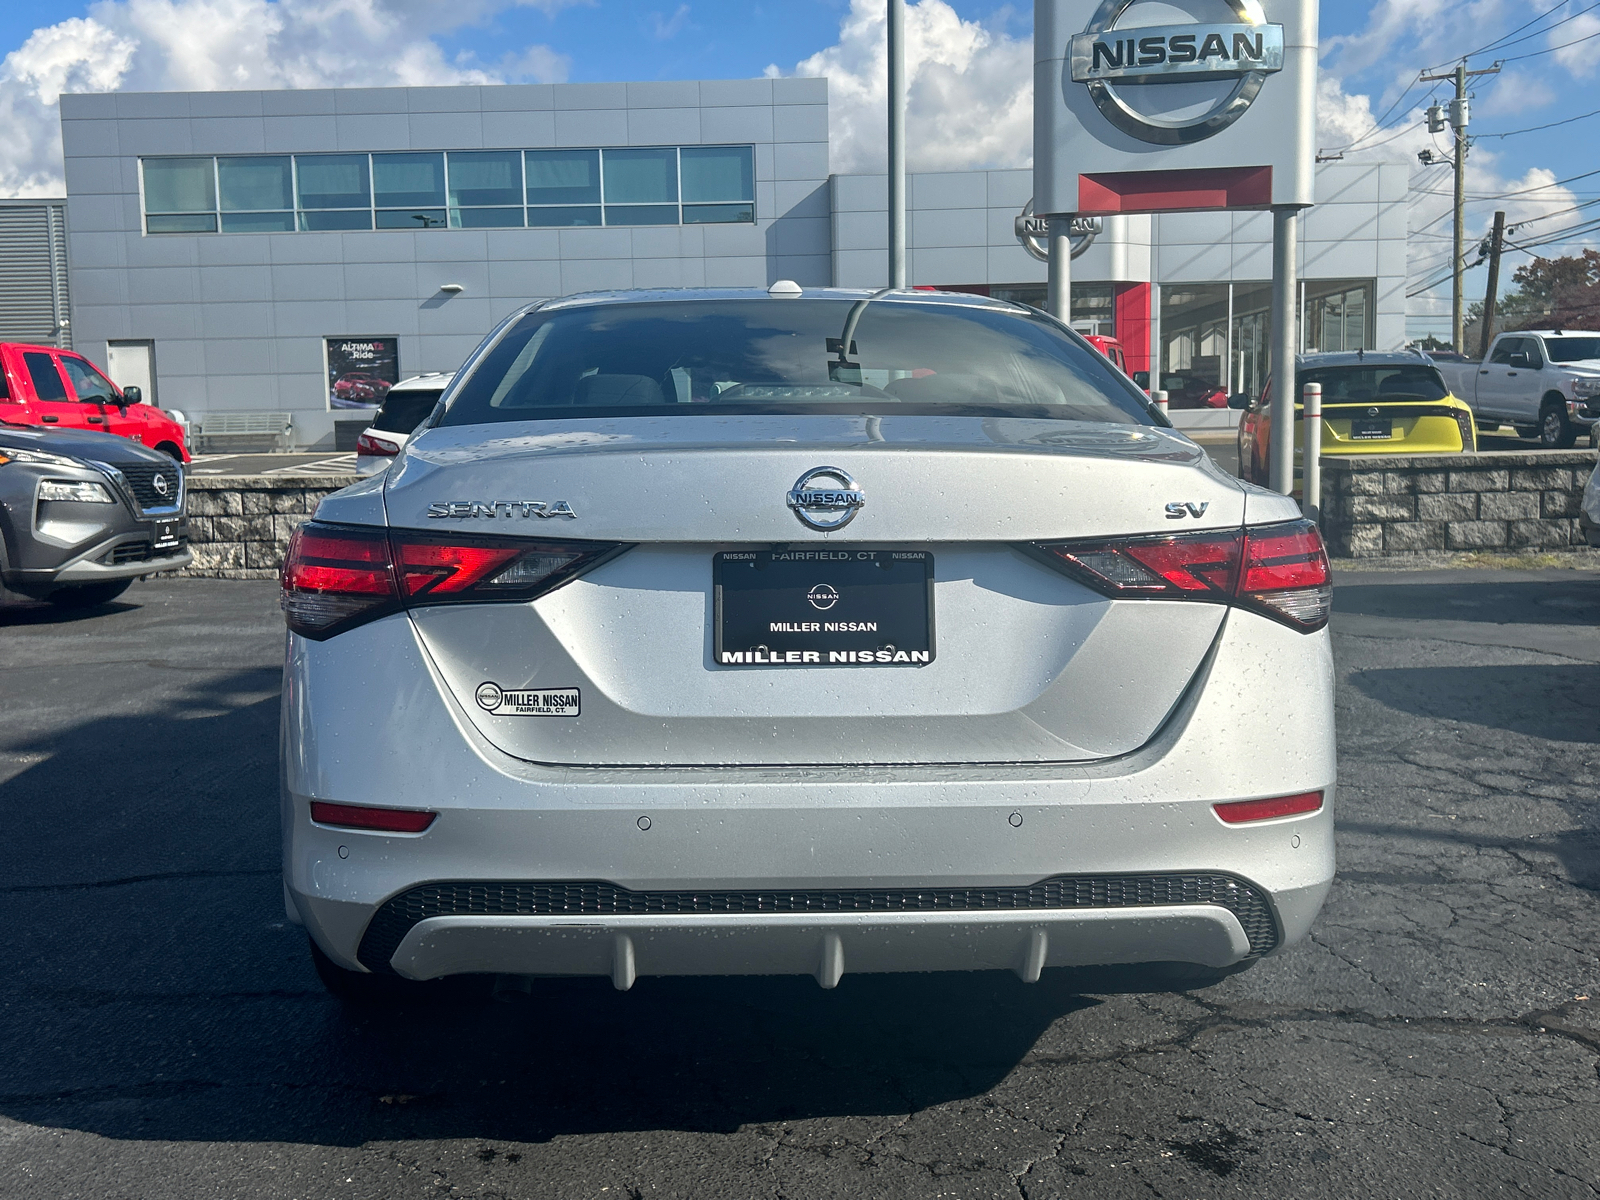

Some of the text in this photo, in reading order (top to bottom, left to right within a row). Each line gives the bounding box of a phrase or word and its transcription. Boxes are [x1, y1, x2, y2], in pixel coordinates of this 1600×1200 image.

[1092, 33, 1263, 69] NISSAN
[1024, 218, 1095, 232] NIAN
[352, 351, 374, 359] Ride
[796, 493, 857, 503] NISSAN
[427, 500, 577, 518] SENTRA
[1165, 502, 1209, 519] SV
[857, 551, 877, 560] CT
[892, 552, 925, 560] NISSAN
[770, 622, 877, 632] MILLER NISSAN
[722, 650, 929, 663] MILLER NISSAN
[504, 693, 577, 707] MILLER NISSAN
